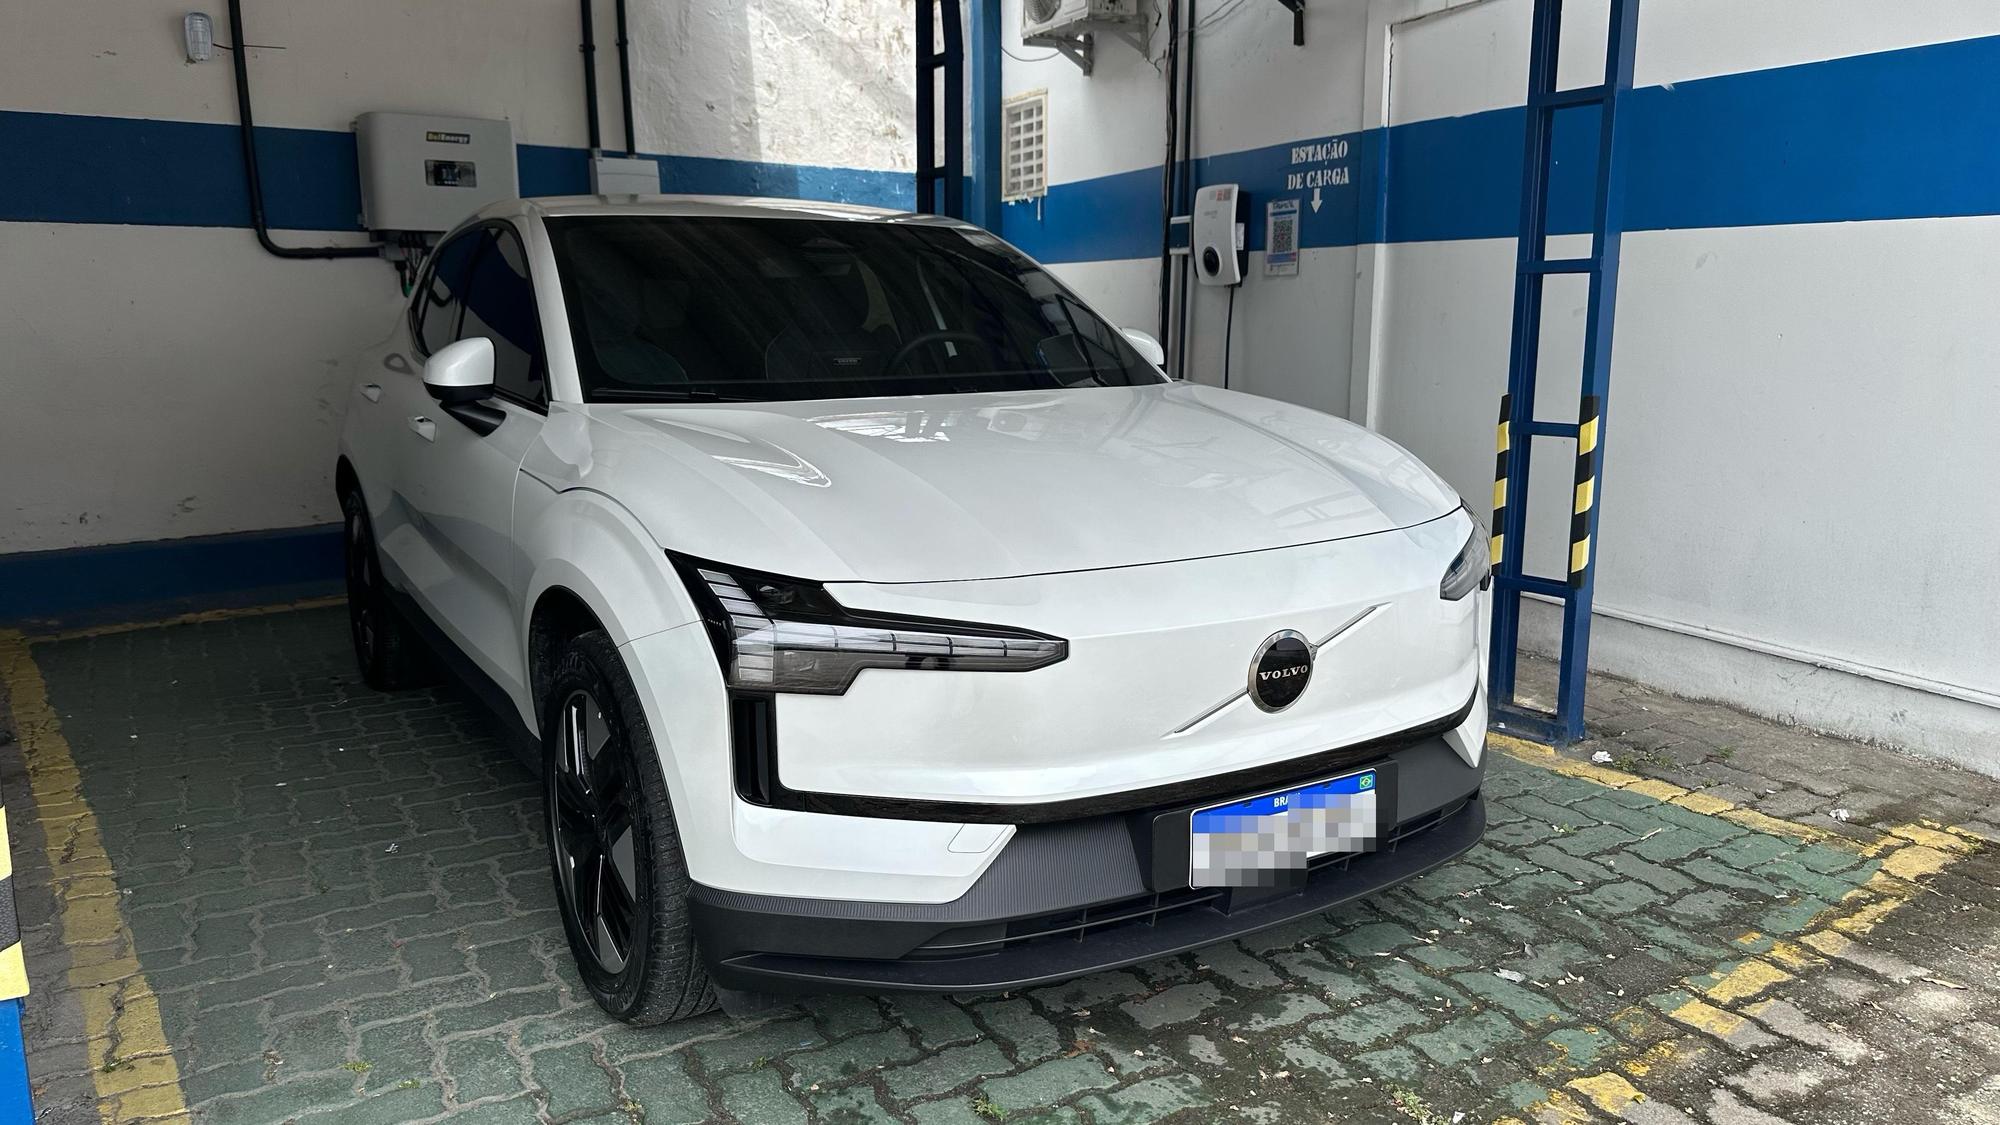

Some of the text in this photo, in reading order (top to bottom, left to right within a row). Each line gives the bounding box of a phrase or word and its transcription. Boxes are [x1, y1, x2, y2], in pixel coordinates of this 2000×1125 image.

[1291, 139, 1349, 166] ESTAÇÃO
[1288, 167, 1350, 190] DE CARGA
[1259, 665, 1309, 681] VOLVO
